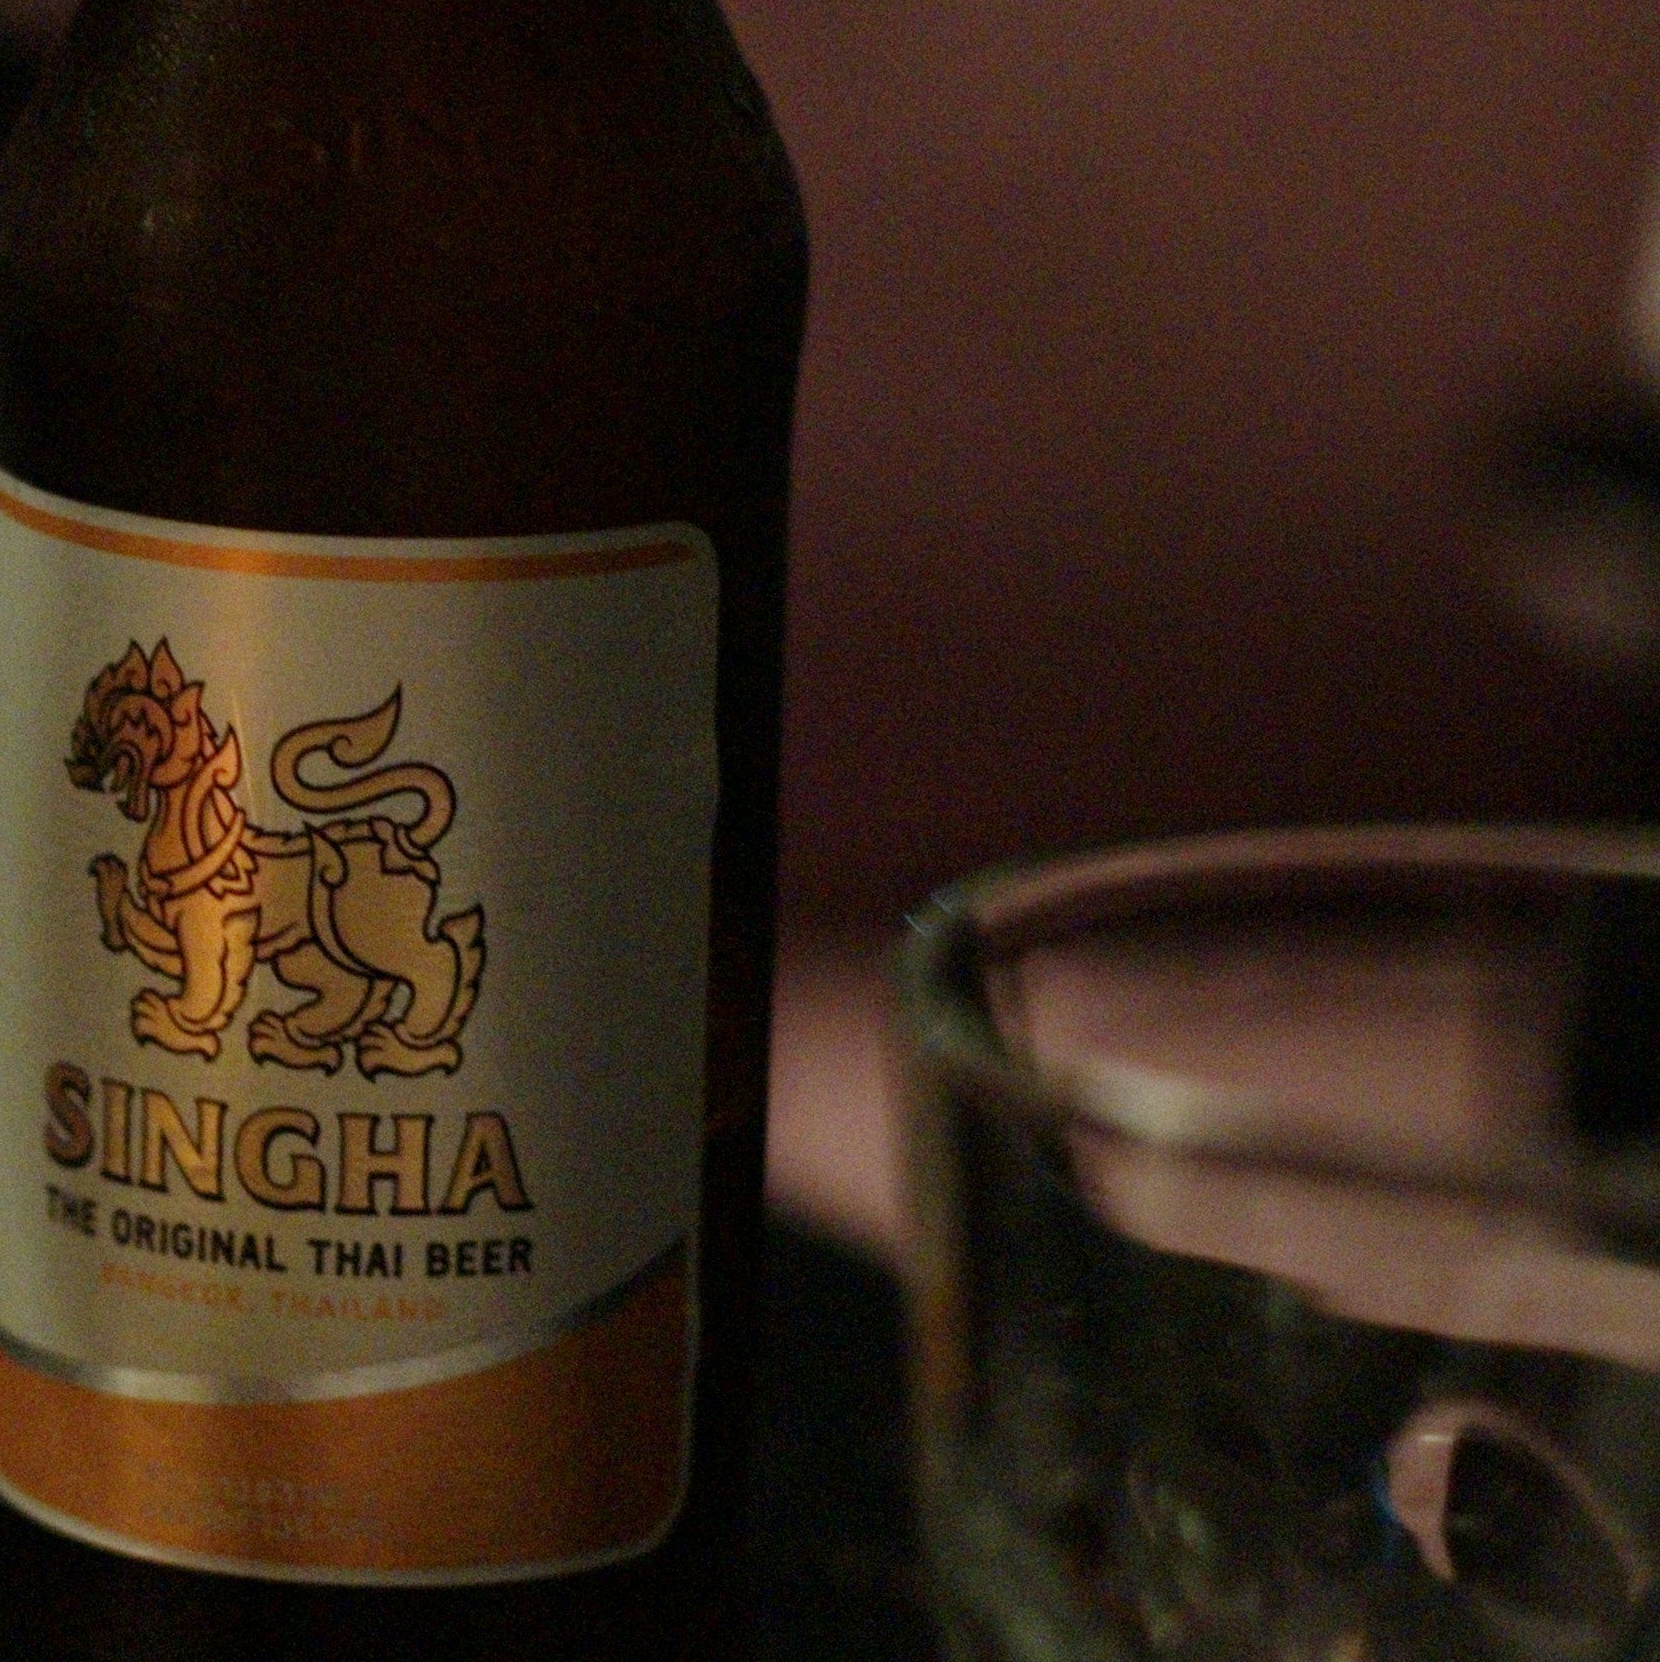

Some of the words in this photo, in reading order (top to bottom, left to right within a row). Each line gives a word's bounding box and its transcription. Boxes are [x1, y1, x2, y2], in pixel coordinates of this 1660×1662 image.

[43, 1061, 534, 1217] SINGHA
[44, 1185, 97, 1236] THE
[110, 1210, 287, 1276] ORIGINAL
[307, 1238, 404, 1279] THAI
[426, 1236, 533, 1278] BEER
